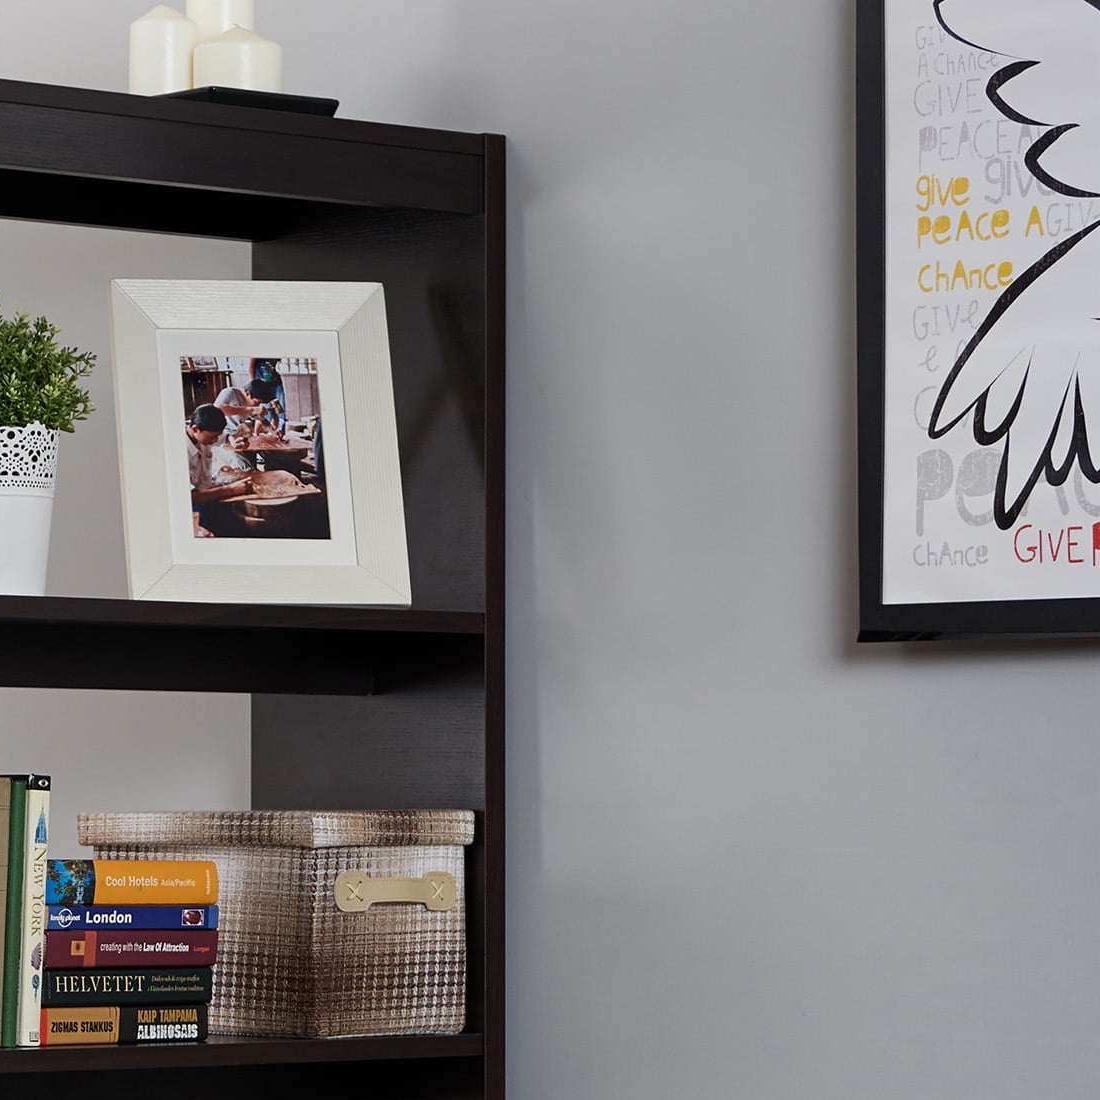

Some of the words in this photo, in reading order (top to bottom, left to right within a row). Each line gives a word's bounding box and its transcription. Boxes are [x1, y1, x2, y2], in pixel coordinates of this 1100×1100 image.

[916, 26, 947, 50] GIV
[913, 78, 983, 117] GIVE
[915, 173, 970, 212] give
[1024, 205, 1045, 238] A
[1046, 202, 1100, 237] GIV
[1013, 524, 1085, 565] GIVE
[33, 846, 48, 889] NEW
[105, 874, 126, 887] Cool
[128, 874, 158, 887] Hotels
[161, 878, 196, 887] Asia/Pacific
[30, 891, 46, 936] YORK
[50, 913, 66, 923] lonely
[65, 913, 81, 922] planet
[85, 910, 132, 924] London
[100, 942, 121, 953] creating
[122, 942, 133, 952] with
[133, 942, 143, 952] the
[143, 942, 155, 952] Law
[155, 942, 162, 952] Of
[162, 942, 189, 952] Attraction
[55, 975, 146, 993] HELVETET
[51, 1021, 79, 1033] ZIGMAS
[80, 1021, 114, 1033] STANKUS
[137, 1009, 157, 1023] KAIP
[159, 1008, 198, 1022] TAMPAMA
[137, 1023, 199, 1040] ALBINOSAIS
